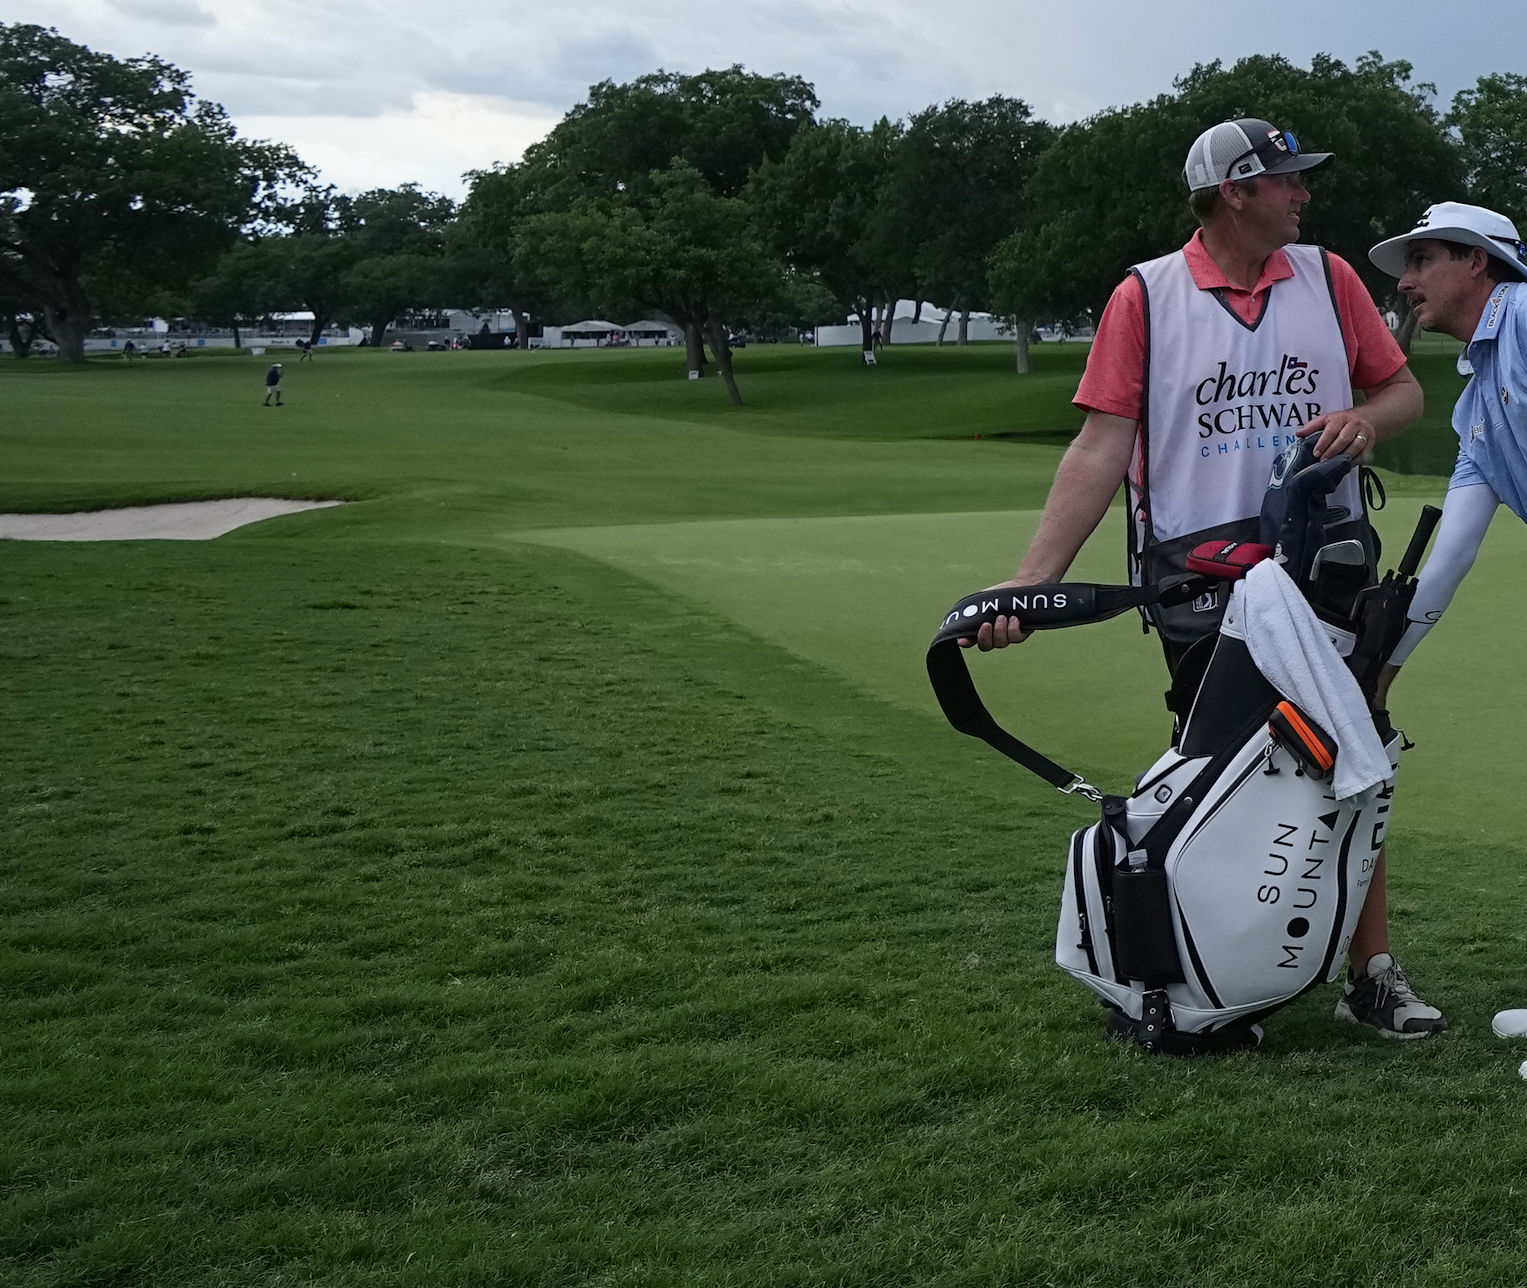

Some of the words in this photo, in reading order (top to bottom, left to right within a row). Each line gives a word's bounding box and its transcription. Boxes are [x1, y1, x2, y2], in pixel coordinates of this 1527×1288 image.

[1196, 354, 1320, 406] charles
[1013, 594, 1067, 610] SUN
[1257, 823, 1298, 904] SUN
